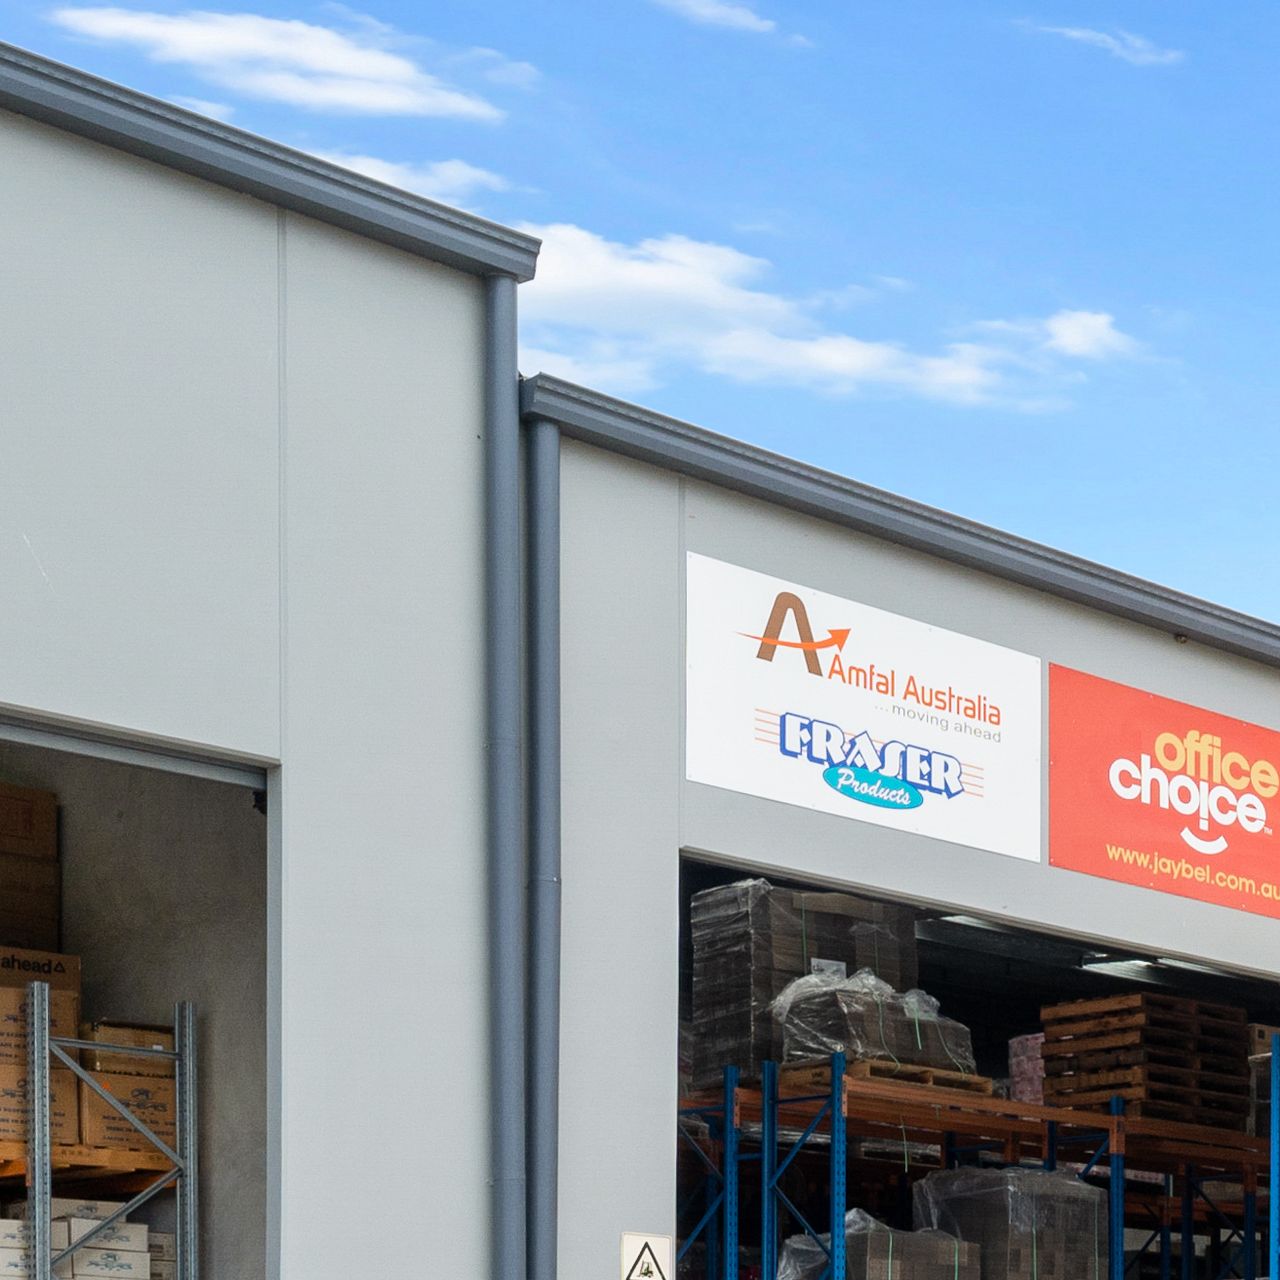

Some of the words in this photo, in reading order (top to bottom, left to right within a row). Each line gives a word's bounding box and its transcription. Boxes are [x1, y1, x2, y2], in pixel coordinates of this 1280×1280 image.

[827, 654, 896, 699] Amfal
[903, 675, 1002, 727] Australia
[779, 711, 965, 800] FRASER
[954, 722, 1002, 744] ahead
[1154, 729, 1280, 798] office
[836, 768, 912, 807] Products
[1108, 754, 1266, 834] choice
